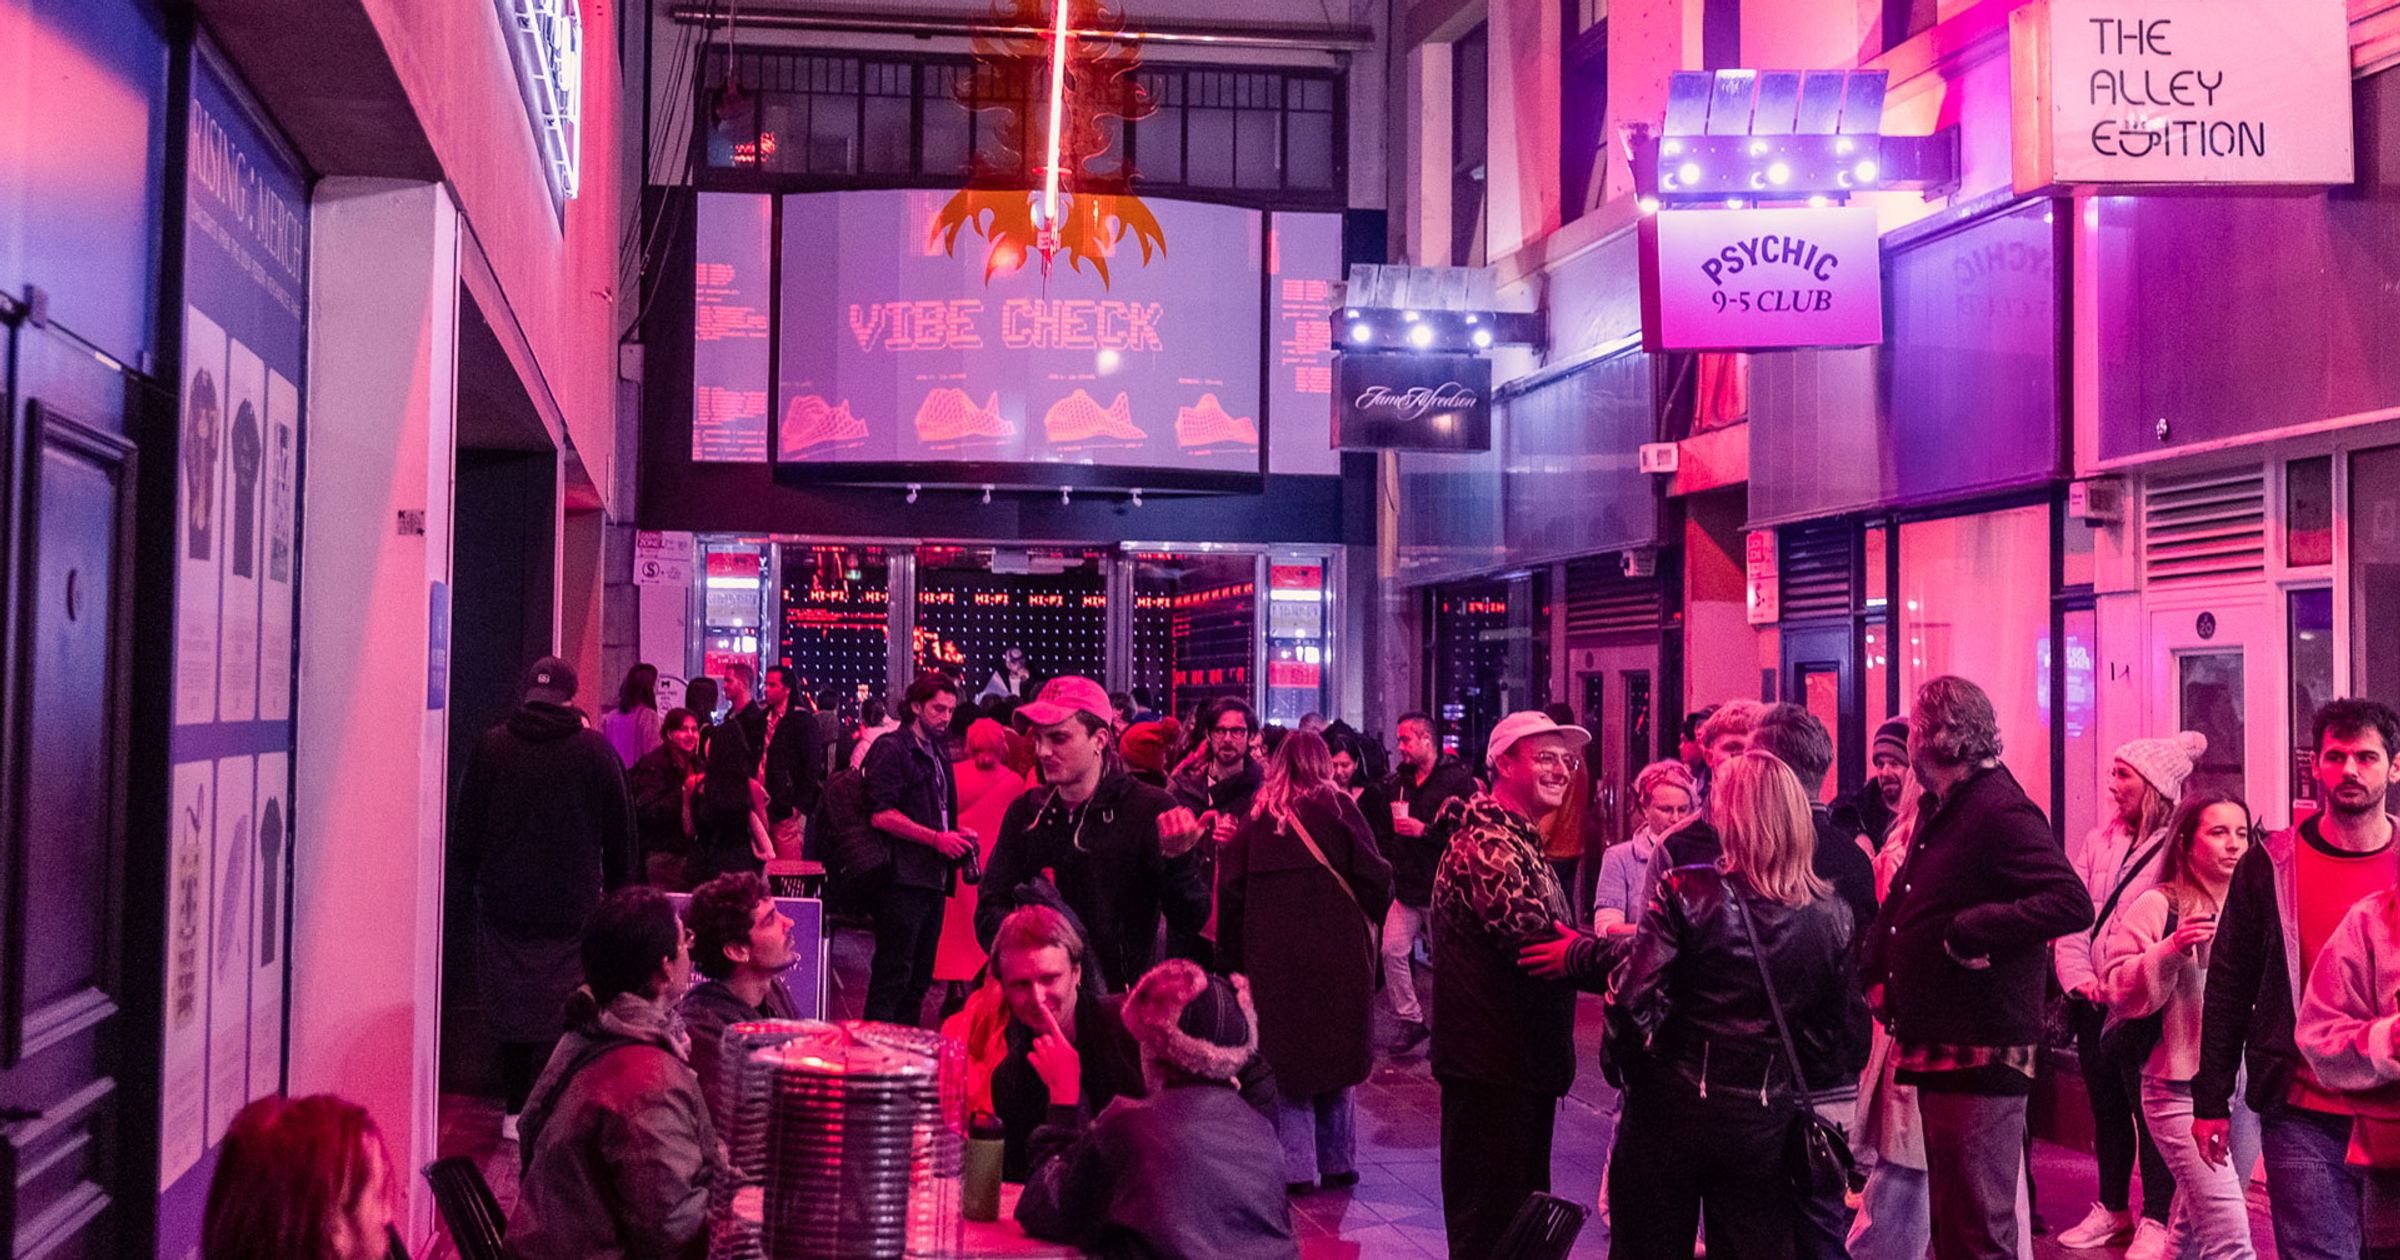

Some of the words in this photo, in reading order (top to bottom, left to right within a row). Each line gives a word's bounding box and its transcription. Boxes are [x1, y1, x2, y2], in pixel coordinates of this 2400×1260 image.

[2089, 18, 2171, 56] THE
[2090, 69, 2223, 106] ALLEY
[192, 98, 246, 223] RISING
[257, 176, 303, 284] MERCH
[1701, 235, 1839, 286] PSYCHIC
[1712, 290, 1751, 313] 9-5
[1757, 289, 1833, 313] CLUB
[850, 300, 985, 352] VIBE
[1002, 299, 1164, 352] CHECK
